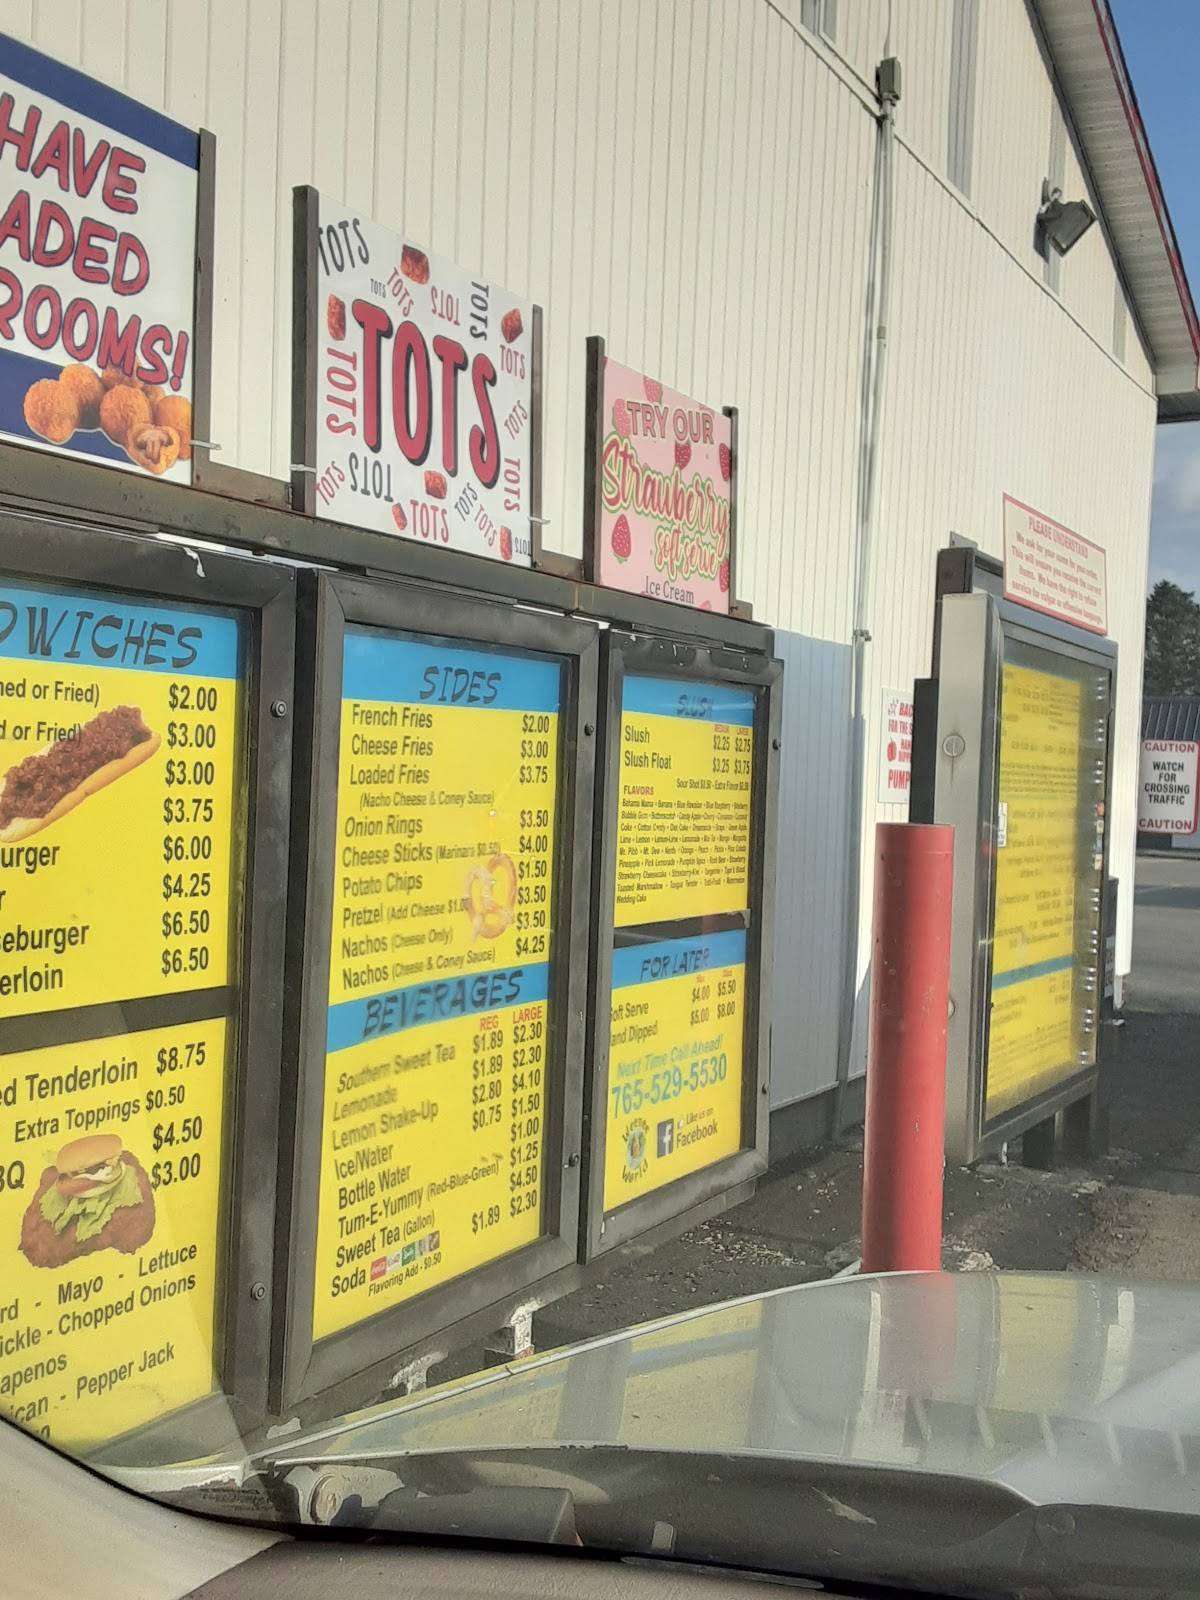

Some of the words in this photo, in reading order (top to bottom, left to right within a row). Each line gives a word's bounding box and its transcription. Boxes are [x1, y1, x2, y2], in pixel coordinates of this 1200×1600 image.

[0, 92, 146, 215] HAVE
[318, 217, 370, 276] TOTS
[370, 278, 386, 298] TOTS
[386, 267, 414, 317] TOTS
[469, 281, 490, 341] TOTS
[500, 344, 526, 380] TOTS
[326, 347, 357, 436] TOTS
[351, 298, 500, 489] TOTS
[503, 399, 528, 440] TOTS
[626, 400, 669, 439] TRY
[673, 408, 715, 445] OUR
[316, 460, 346, 506] TOTS
[454, 482, 478, 522] TOTS
[503, 457, 521, 512] TOTS
[603, 435, 728, 559] Strawberry
[410, 499, 449, 543] TOTS
[474, 504, 497, 547] TOTS
[655, 527, 682, 579] soft
[644, 575, 661, 596] Ice
[662, 580, 694, 605] Cream
[32, 684, 49, 700] or
[54, 681, 100, 708] Fried)
[169, 683, 218, 712] $2.00
[419, 665, 502, 704] SIDES
[12, 725, 31, 740] or
[36, 722, 82, 748] Fried)
[167, 721, 216, 752] $3.00
[352, 703, 398, 727] French
[401, 706, 433, 729] Fries
[522, 714, 550, 734] $2.00
[624, 725, 650, 743] Slush
[713, 734, 730, 751] $2.25
[735, 737, 751, 752] $2.75
[352, 733, 398, 756] Cheese
[401, 736, 434, 756] Fries
[520, 740, 549, 759] $3.00
[624, 750, 649, 768] Slush
[651, 752, 672, 769] Float
[713, 757, 729, 774] $3.25
[1144, 742, 1195, 753] CAUTION
[165, 758, 215, 788] $3.00
[350, 763, 395, 785] Loaded
[399, 764, 430, 785] Fries
[519, 765, 548, 784] $3.75
[1153, 761, 1185, 772] WATCH
[1158, 772, 1177, 782] FOR
[623, 784, 654, 796] FLAVORS
[1144, 782, 1190, 794] CROSSING
[1148, 794, 1185, 805] TRAFFIC
[163, 796, 213, 826] $3.75
[344, 816, 383, 837] Onion
[386, 815, 423, 839] Rings
[520, 809, 549, 829] $3.50
[1138, 818, 1192, 830] CAUTION
[163, 835, 212, 864] $6.00
[342, 846, 389, 868] Cheese
[394, 842, 433, 863] Sticks
[519, 835, 548, 854] $4.00
[162, 872, 211, 902] $4.25
[343, 877, 382, 898] Potato
[386, 871, 423, 896] Chips
[518, 860, 547, 880] $1.50
[162, 909, 210, 940] $6.50
[343, 907, 383, 929] Pretzel
[518, 885, 546, 905] $3.50
[342, 937, 387, 960] Nachos
[517, 909, 545, 932] $3.50
[162, 946, 209, 978] $6.50
[343, 965, 389, 990] Nachos
[516, 935, 545, 957] $4.25
[640, 954, 670, 981] FOR
[363, 969, 524, 1038] BEVERAGES
[480, 1015, 499, 1031] REG
[512, 1006, 543, 1024] LARGE
[626, 1002, 649, 1019] Serve
[692, 985, 710, 1003] $4.00
[718, 979, 736, 997] $5.50
[611, 1027, 627, 1046] and
[628, 1020, 658, 1043] Dipped
[671, 1043, 689, 1062] Call
[25, 1057, 138, 1101] Tenderloin
[157, 1041, 206, 1076] $8.75
[337, 1062, 391, 1094] Southern
[435, 1043, 456, 1063] Tea
[473, 1030, 503, 1054] $1.89
[513, 1022, 542, 1044] $2.30
[473, 1055, 503, 1080] $1.89
[513, 1045, 542, 1069] $2.30
[612, 1053, 727, 1120] 765-529-5530
[15, 1117, 59, 1143] Extra
[65, 1098, 141, 1131] Toppings
[146, 1084, 185, 1113] $0.50
[332, 1122, 377, 1150] Lemon
[380, 1099, 439, 1134] Shake-Up
[472, 1079, 502, 1106] $2.80
[512, 1069, 541, 1094] $4.10
[472, 1104, 502, 1132] $0.75
[512, 1092, 540, 1118] $1.50
[153, 1115, 202, 1153] $4.50
[676, 1118, 718, 1149] Facebook
[151, 1152, 201, 1192] $3.00
[338, 1180, 375, 1211] Bottle
[378, 1165, 411, 1194] Water
[511, 1117, 540, 1143] $1.00
[338, 1186, 424, 1239] Tum-E-Yummy
[427, 1159, 500, 1202] (Red-Blue-Green)
[510, 1140, 539, 1168] $1.25
[335, 1234, 377, 1268] Sweet
[380, 1225, 400, 1249] Tea
[403, 1209, 435, 1242] (Gallon)
[510, 1165, 538, 1192] $4.50
[331, 1267, 366, 1298] Soda
[472, 1205, 500, 1236] $1.89
[510, 1189, 538, 1217] $2.30
[58, 1275, 104, 1306] Mayo
[139, 1243, 197, 1278] Lettuce
[368, 1271, 404, 1297] Flavoring
[405, 1261, 419, 1278] Add
[424, 1252, 442, 1271] $0.50
[58, 1291, 135, 1336] Chopped
[140, 1273, 196, 1307] Onions
[76, 1361, 135, 1400] Pepper
[138, 1341, 175, 1373] Jack
